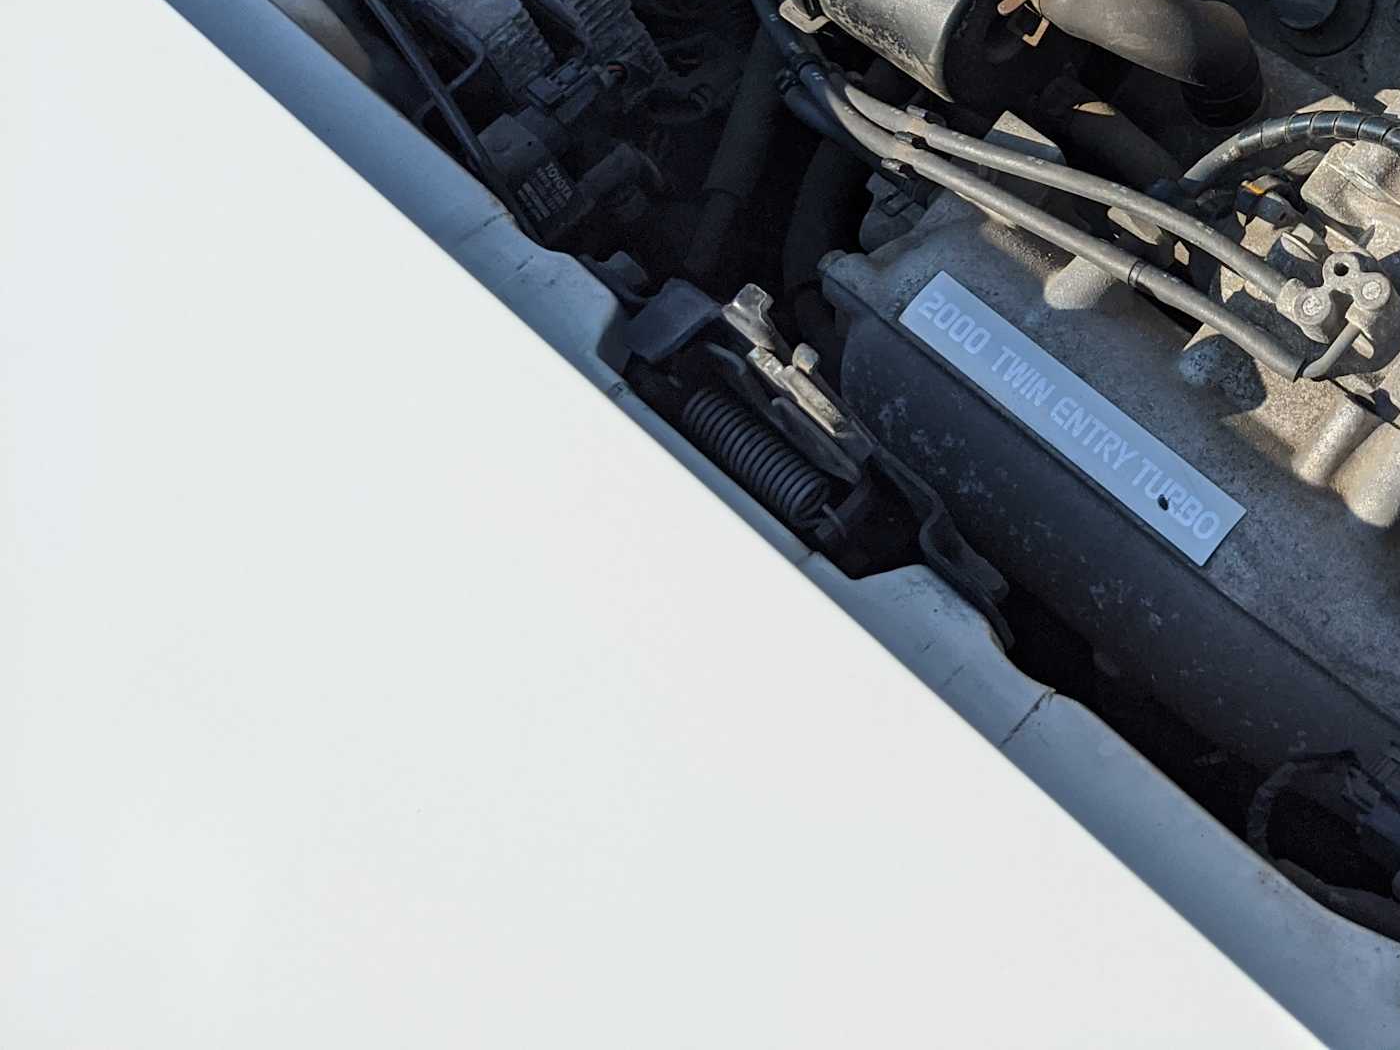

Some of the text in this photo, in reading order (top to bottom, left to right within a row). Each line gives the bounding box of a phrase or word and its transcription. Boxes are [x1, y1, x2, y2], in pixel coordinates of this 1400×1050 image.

[544, 162, 574, 200] TOYOTA
[917, 290, 1222, 540] 2000 TWIN ENTRY TURBO
